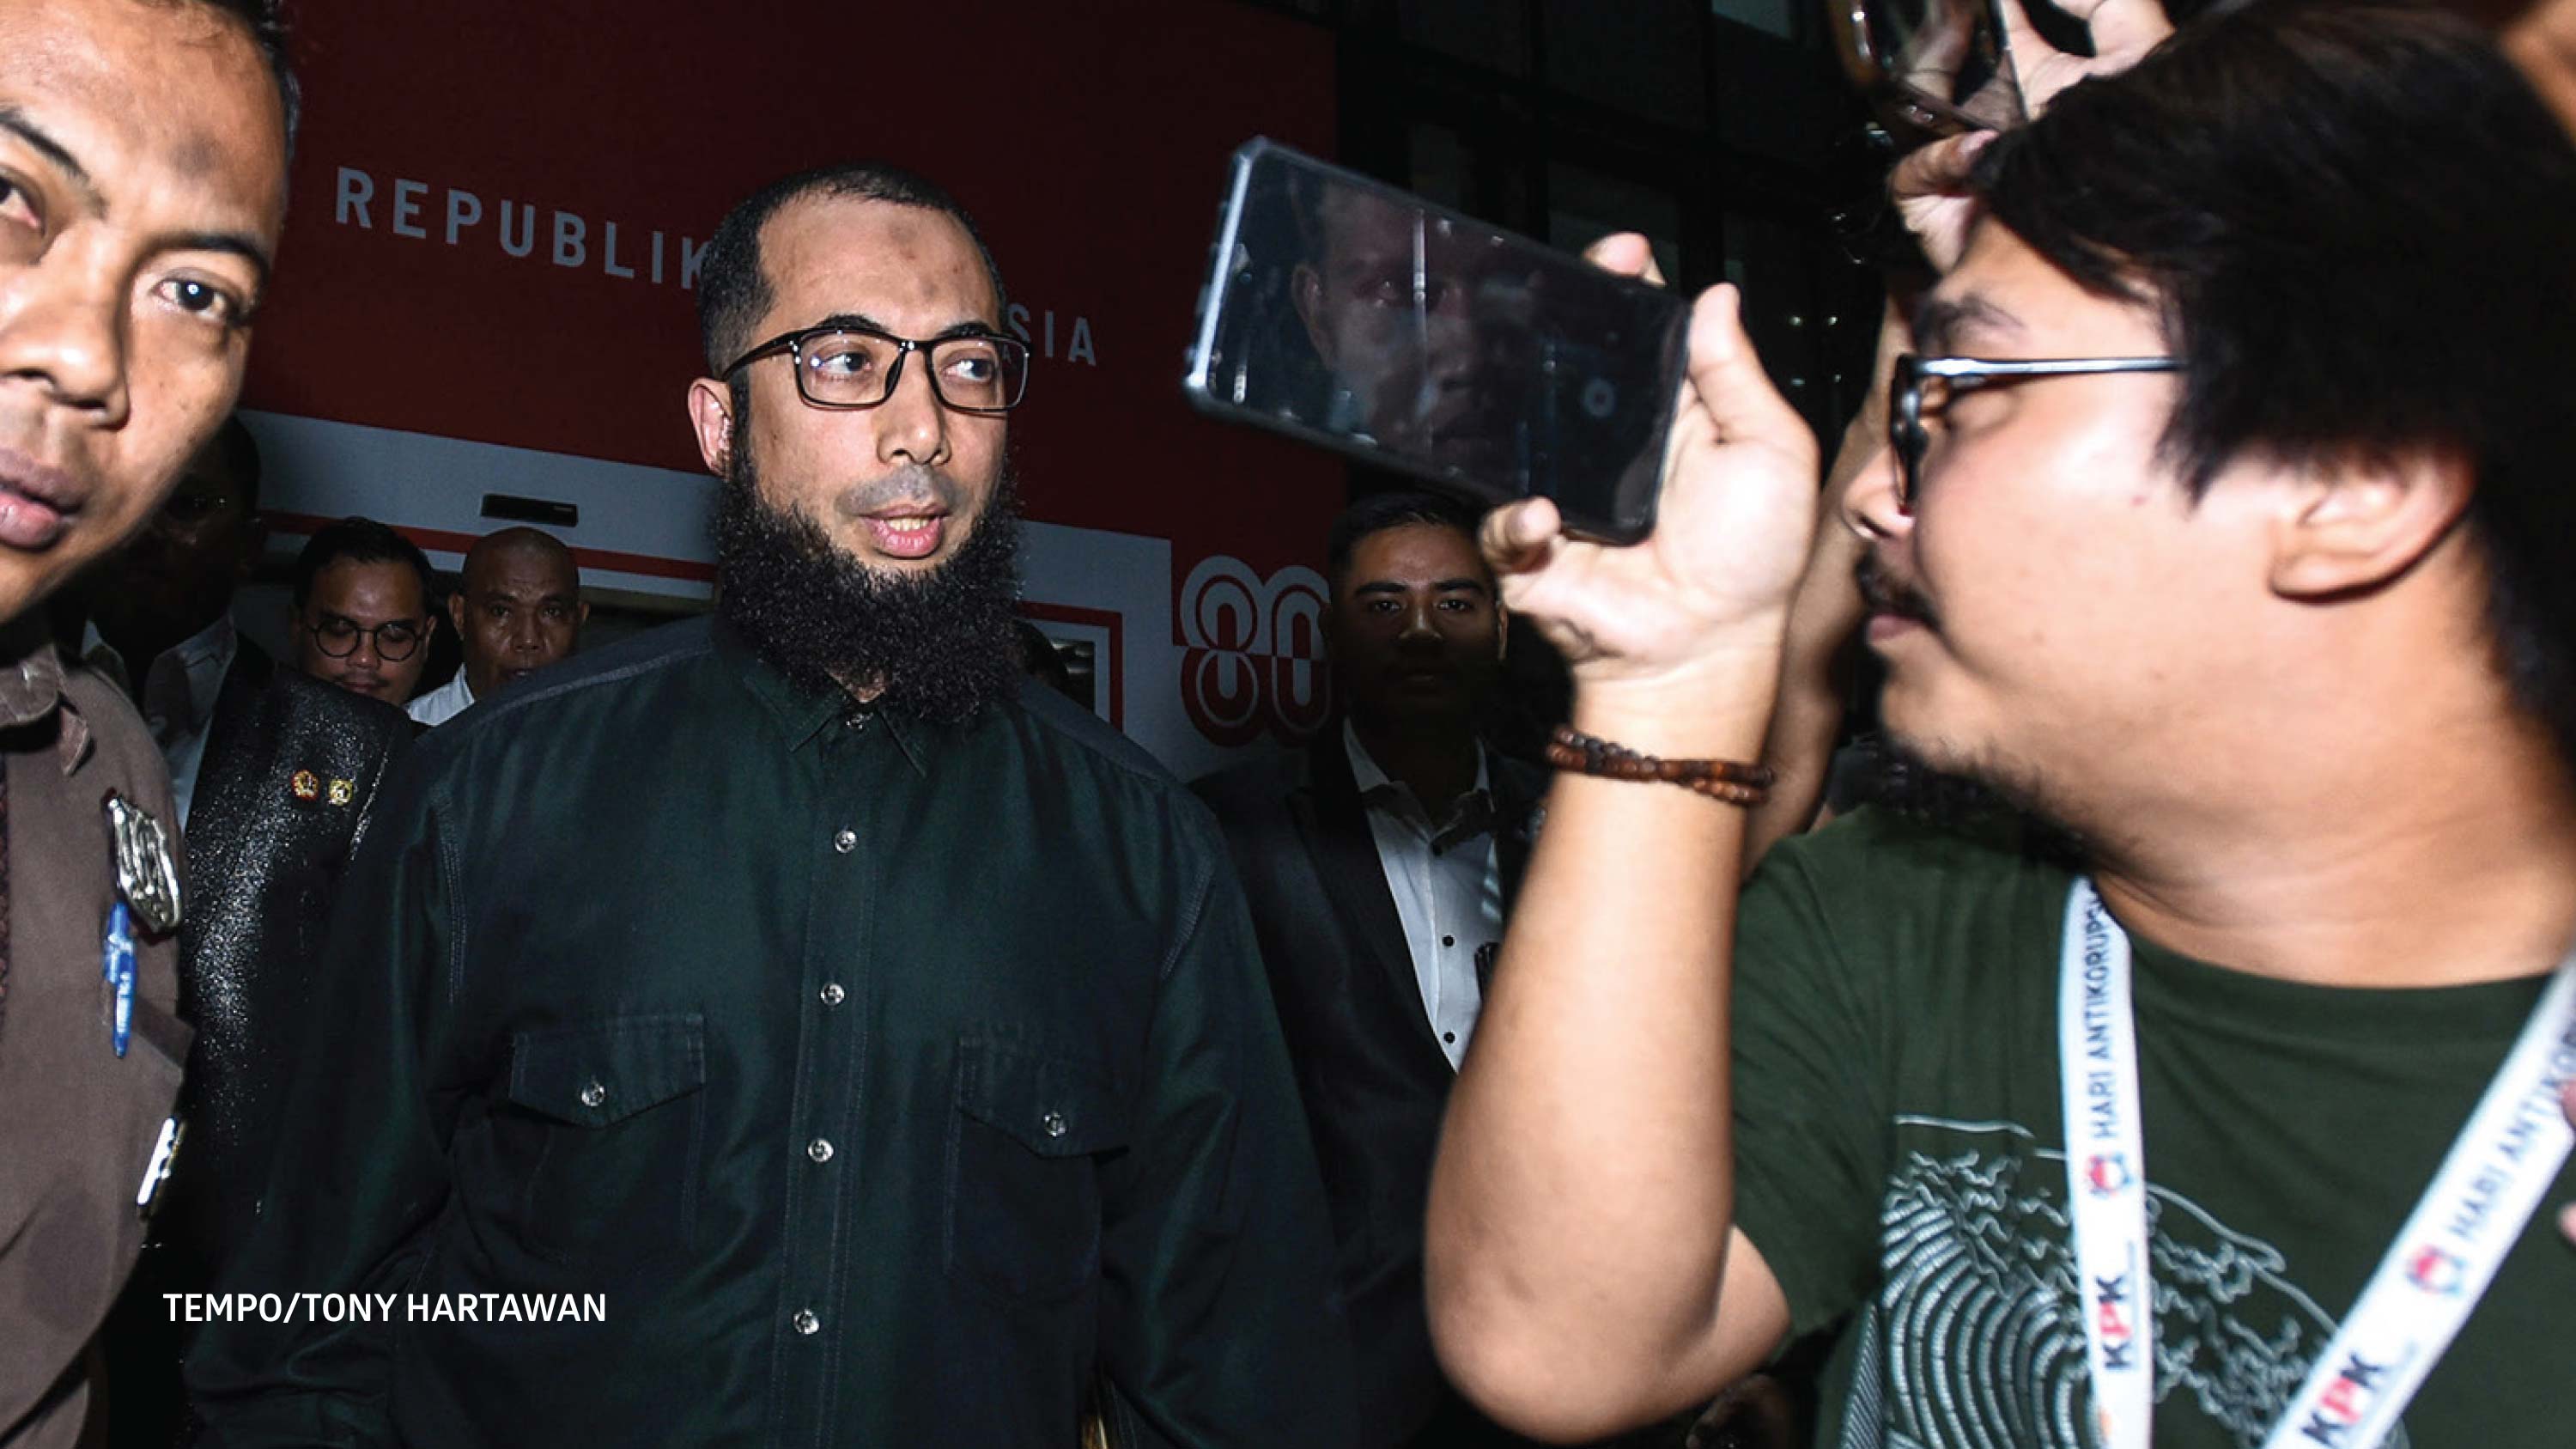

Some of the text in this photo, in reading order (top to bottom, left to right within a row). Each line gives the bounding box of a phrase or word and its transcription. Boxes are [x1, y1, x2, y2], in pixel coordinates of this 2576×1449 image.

[1180, 555, 1331, 747] 80
[2087, 1070, 2117, 1139] HARI
[2449, 1163, 2512, 1240] HARI
[2095, 1274, 2132, 1369] KPK
[2300, 1352, 2385, 1449] KPK
